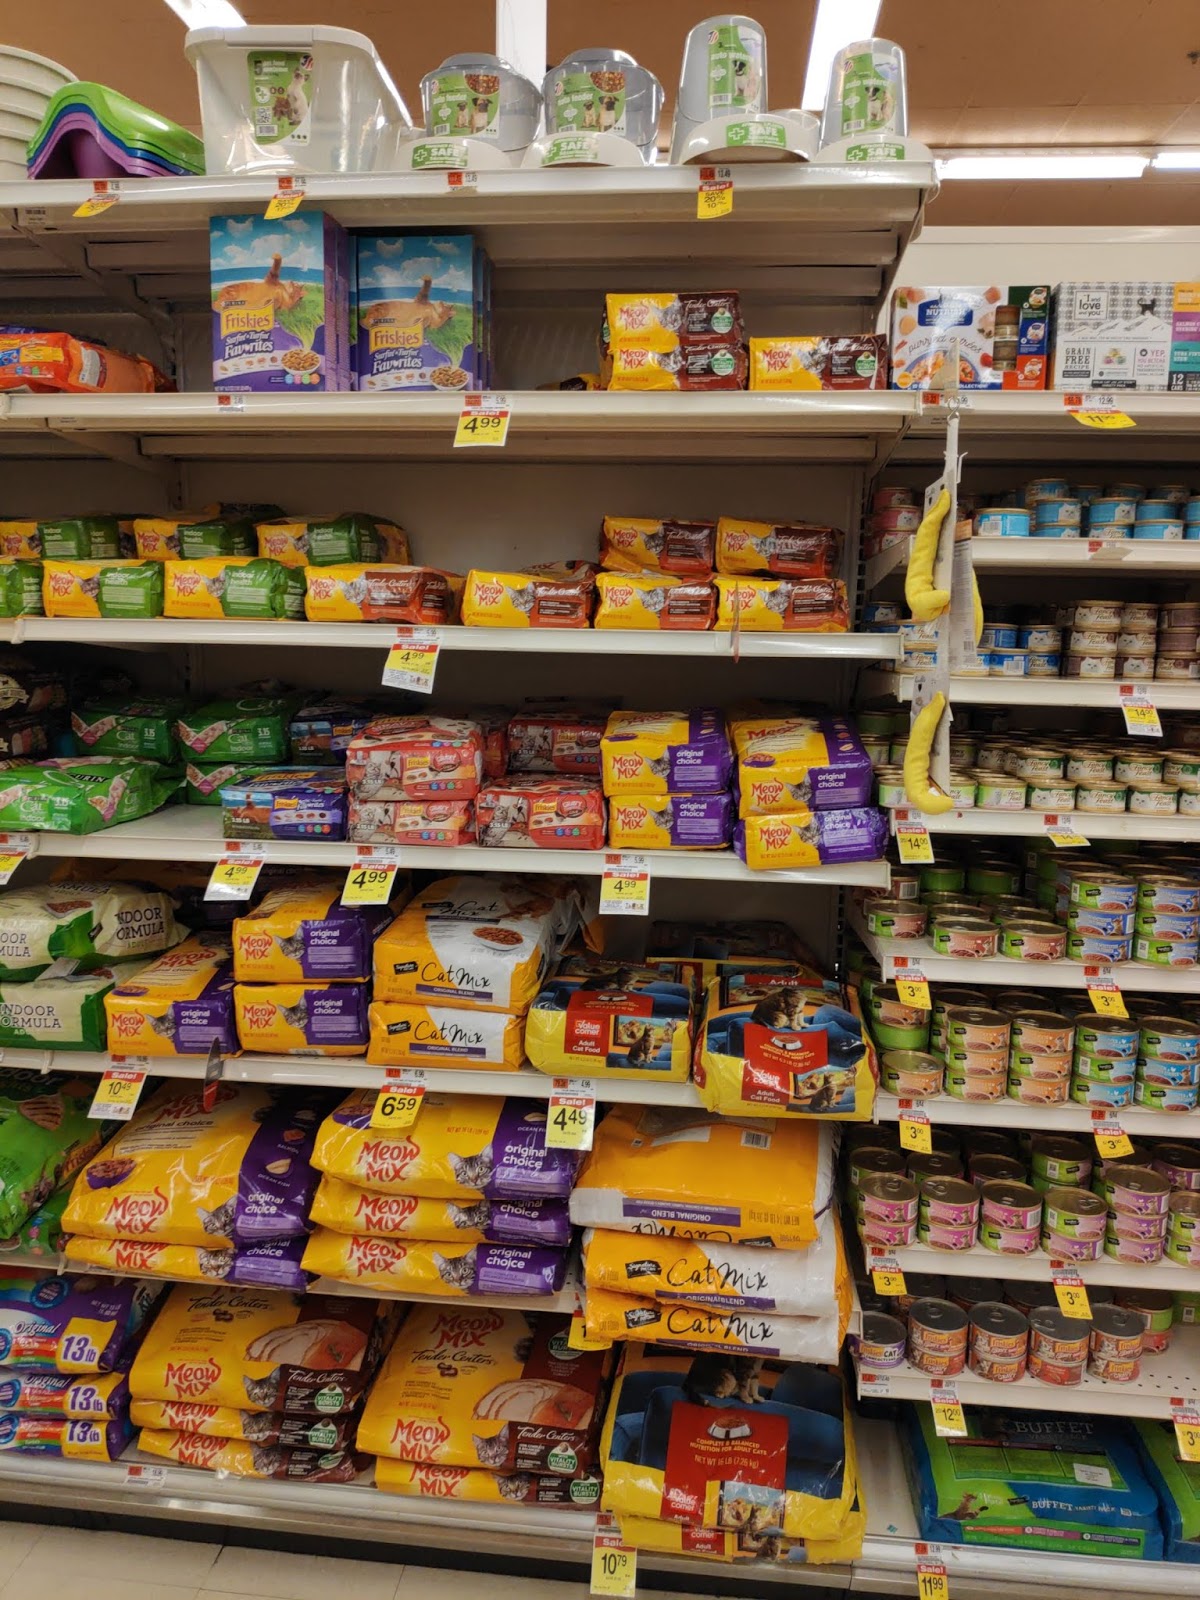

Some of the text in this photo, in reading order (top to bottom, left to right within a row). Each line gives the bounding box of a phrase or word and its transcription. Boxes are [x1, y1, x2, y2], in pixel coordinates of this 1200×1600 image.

[749, 126, 778, 136] SAFE
[1079, 298, 1100, 310] love
[225, 313, 270, 329] Friskies
[374, 330, 419, 347] Friskies
[1065, 356, 1090, 365] FREE
[1172, 374, 1184, 384] 12
[676, 750, 704, 758] original
[407, 758, 430, 768] Friskies
[612, 752, 644, 769] Meow
[676, 757, 702, 765] choice
[818, 772, 846, 782] original
[751, 778, 784, 797] Meow
[818, 780, 844, 788] choice
[616, 804, 648, 820] Meow
[680, 802, 707, 811] original
[759, 821, 792, 840] Meow
[310, 929, 340, 938] original
[239, 931, 273, 950] Meow
[310, 937, 338, 945] choice
[421, 962, 491, 989] Cat Mix
[433, 987, 457, 995] ORIGINAL
[314, 999, 343, 1008] original
[181, 1008, 210, 1019] original
[314, 1007, 341, 1015] choice
[112, 1008, 145, 1028] Meow
[181, 1017, 208, 1025] choice
[414, 1021, 484, 1046] Cat Mix
[111, 1071, 137, 1081] Sale!
[558, 1098, 587, 1106] Sale!
[356, 1135, 421, 1165] Meow
[505, 1145, 547, 1158] original
[503, 1155, 543, 1169] choice
[105, 1186, 170, 1222] Meow
[248, 1193, 285, 1205] original
[245, 1203, 277, 1215] choice
[355, 1194, 420, 1217] Meow
[500, 1203, 539, 1219] choice
[246, 1246, 283, 1257] choice
[347, 1235, 407, 1261] Meow
[489, 1248, 532, 1260] original
[486, 1256, 526, 1269] choice
[667, 1258, 768, 1294] Cat Mix
[188, 1295, 270, 1312] Tender Centers
[15, 1321, 61, 1334] Original
[430, 1311, 504, 1334] Meow
[667, 1307, 773, 1344] Cat Mix
[62, 1336, 90, 1362] 13
[883, 1350, 898, 1358] CAT
[412, 1349, 493, 1365] Tender Centers
[164, 1358, 221, 1387] Meow
[288, 1369, 346, 1383] Tender Centers
[24, 1375, 71, 1388] Original
[70, 1387, 96, 1411] 13
[390, 1416, 450, 1445] Meow
[517, 1425, 578, 1442] Tender Centers
[1015, 1422, 1094, 1434] BUFFET
[690, 1442, 720, 1452] NUTRITION
[696, 1438, 725, 1446] COMPLETE
[548, 1457, 577, 1466] VITALITY
[551, 1462, 575, 1470] BURSTS
[695, 1455, 705, 1465] NET
[571, 1485, 599, 1493] VITALITY
[573, 1490, 596, 1498] BURSTS
[1032, 1500, 1073, 1512] BUFFET
